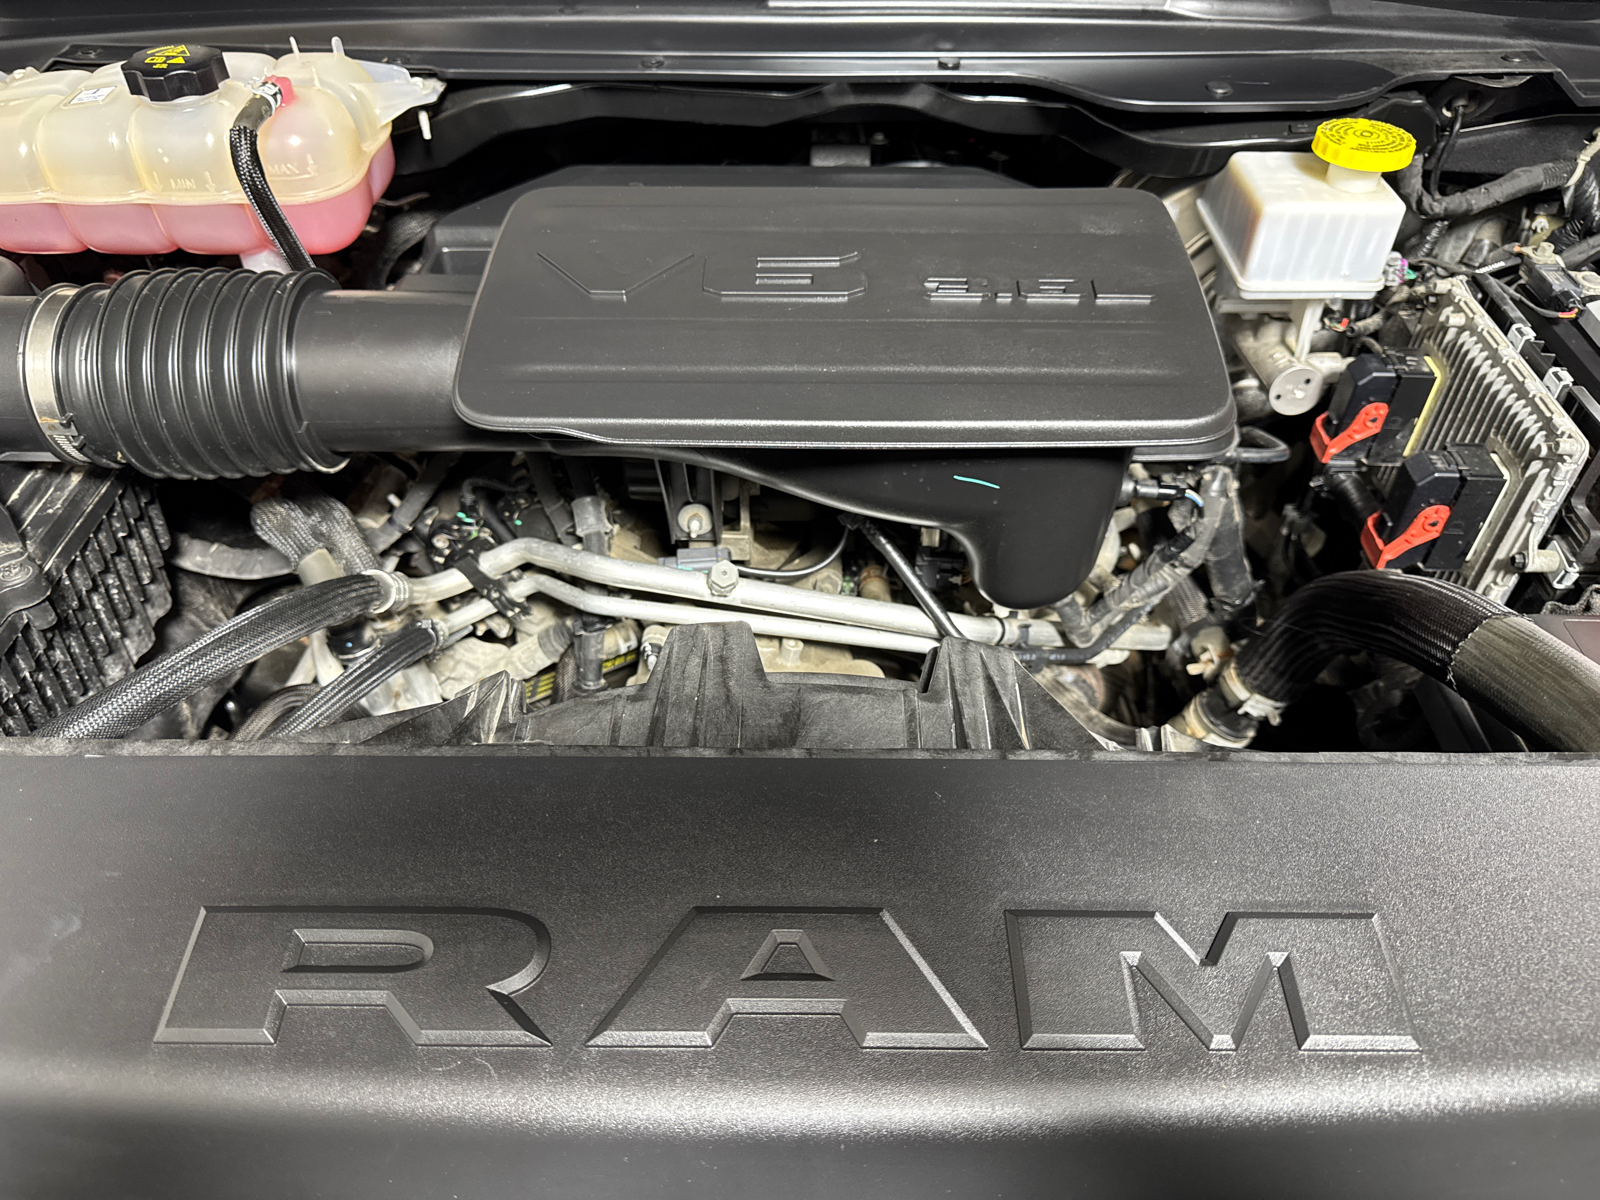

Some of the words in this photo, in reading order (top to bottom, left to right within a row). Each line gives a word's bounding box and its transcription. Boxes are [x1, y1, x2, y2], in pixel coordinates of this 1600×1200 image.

[169, 178, 197, 190] MIN
[267, 163, 300, 175] MAX
[536, 250, 868, 302] V6
[153, 905, 1423, 1053] RAM
